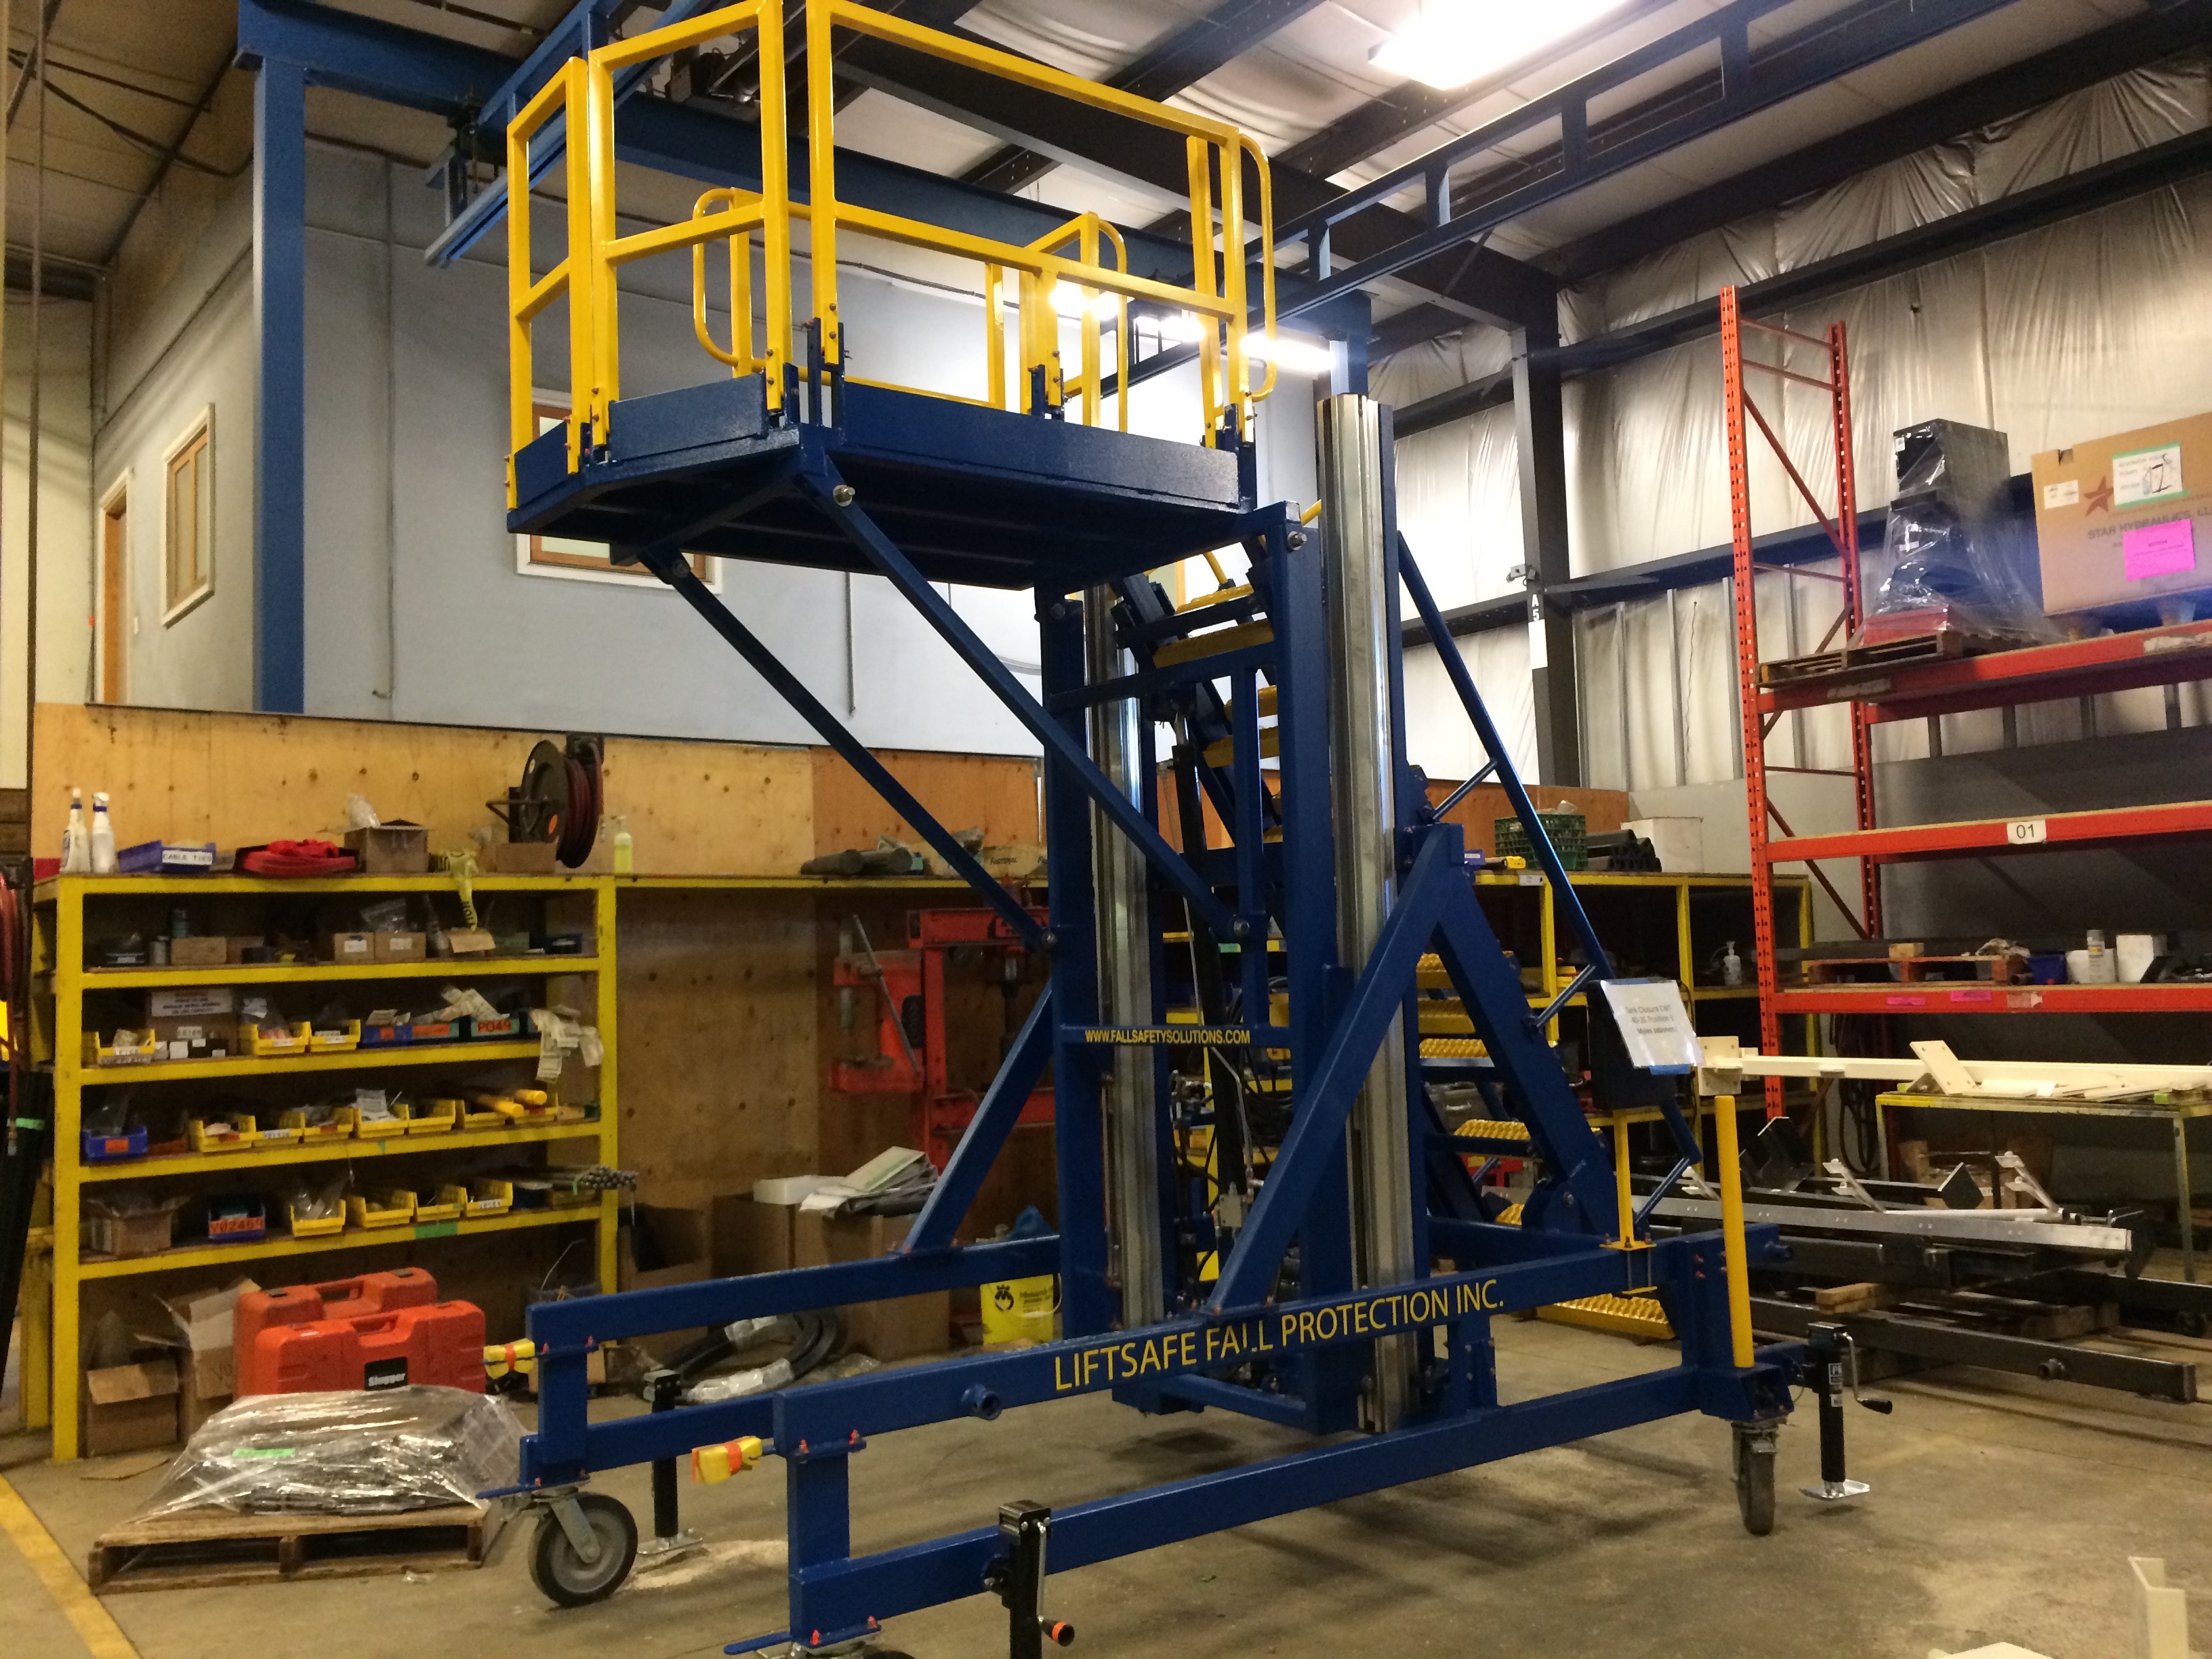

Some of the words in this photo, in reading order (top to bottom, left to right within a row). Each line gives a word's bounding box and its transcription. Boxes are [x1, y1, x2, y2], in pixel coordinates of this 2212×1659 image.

[2088, 526, 2116, 539] STAR
[2016, 823, 2034, 839] 01
[1084, 1029, 1251, 1044] WWW.FALLSAFETYSOLUTIONS.COM
[1054, 1331, 1197, 1391] LIFTSAFE
[1206, 1320, 1273, 1361] FALL
[1281, 1288, 1449, 1347] PROTECTION
[1456, 1279, 1504, 1315] INC.
